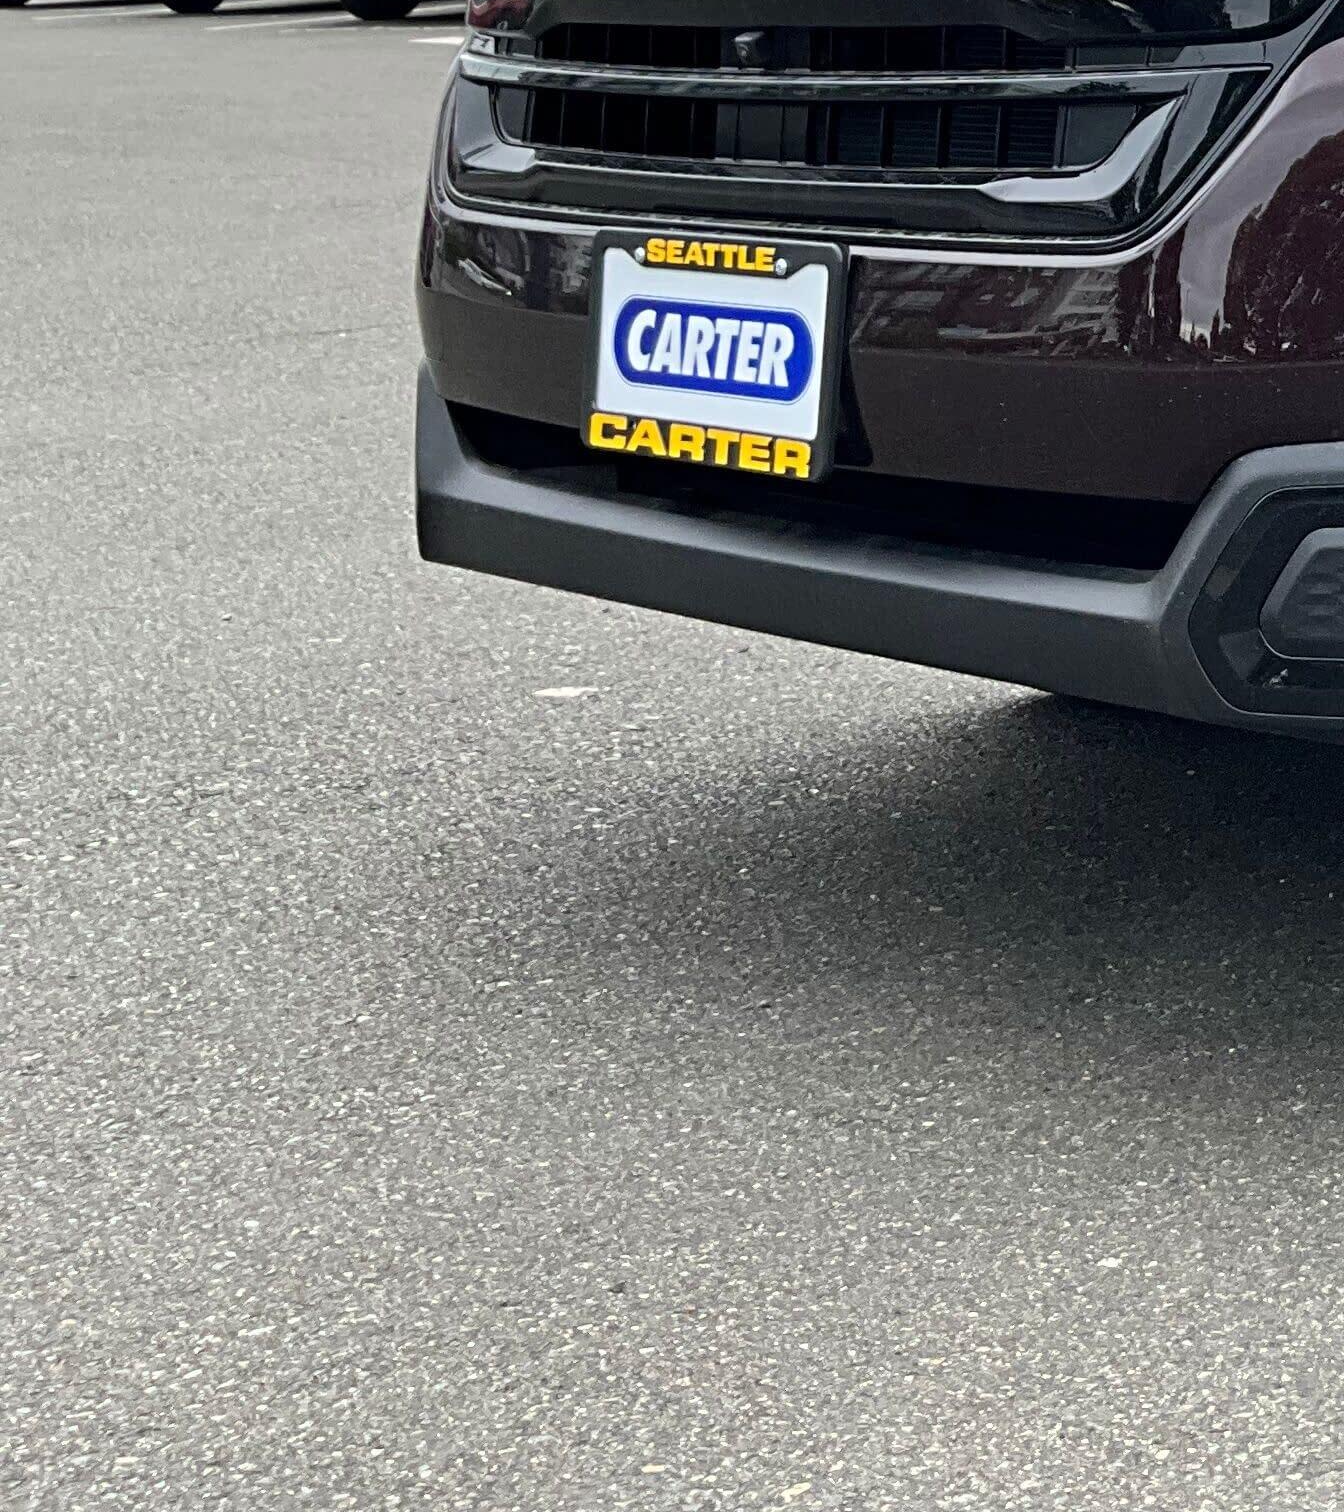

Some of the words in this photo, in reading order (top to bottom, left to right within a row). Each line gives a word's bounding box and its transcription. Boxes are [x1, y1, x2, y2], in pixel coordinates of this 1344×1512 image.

[645, 238, 776, 273] SEATTLE
[627, 309, 796, 388] CARTER
[590, 412, 812, 478] CARTER
